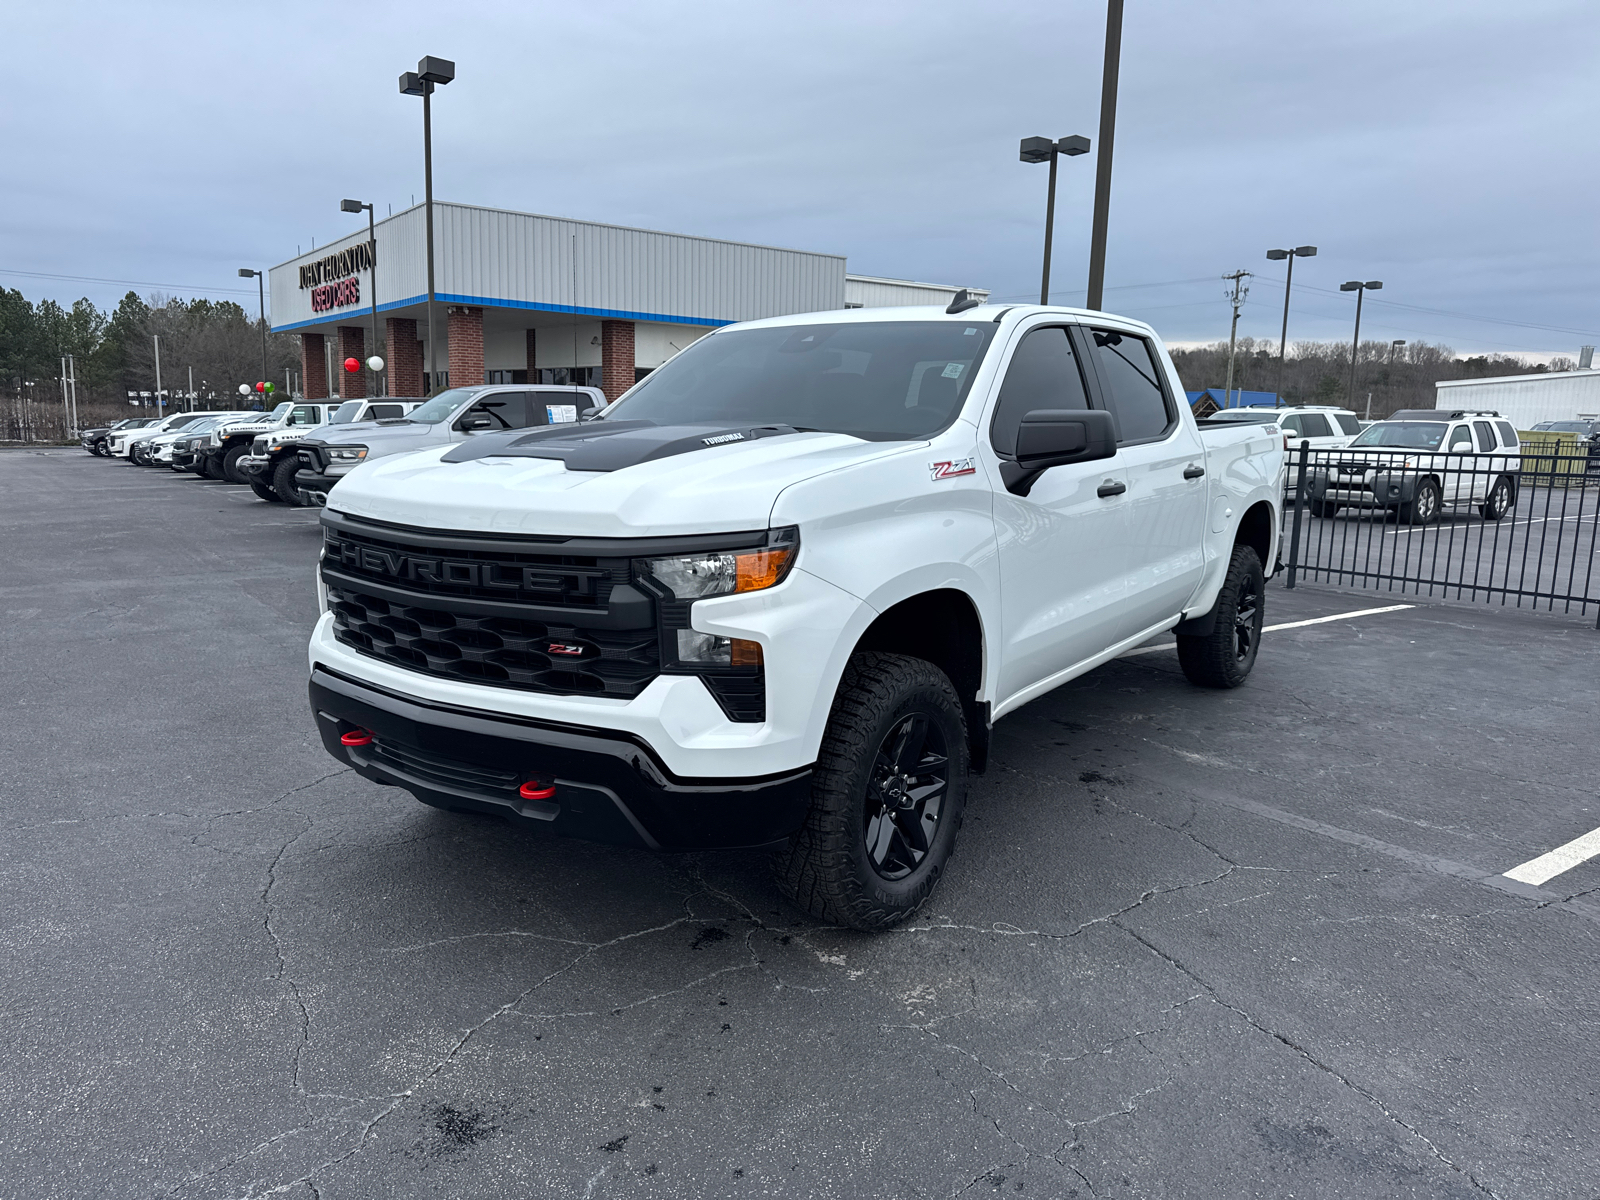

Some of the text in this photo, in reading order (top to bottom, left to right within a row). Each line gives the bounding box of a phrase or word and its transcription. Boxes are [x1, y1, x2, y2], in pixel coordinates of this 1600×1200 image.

[299, 239, 376, 289] JOHN THORNTON
[311, 277, 359, 312] USED CARS
[701, 432, 745, 446] TURBOMAX
[928, 457, 976, 481] Z71
[325, 538, 612, 595] CHEVROLET
[548, 643, 583, 655] Z71
[874, 865, 939, 907] GOODYEAR
